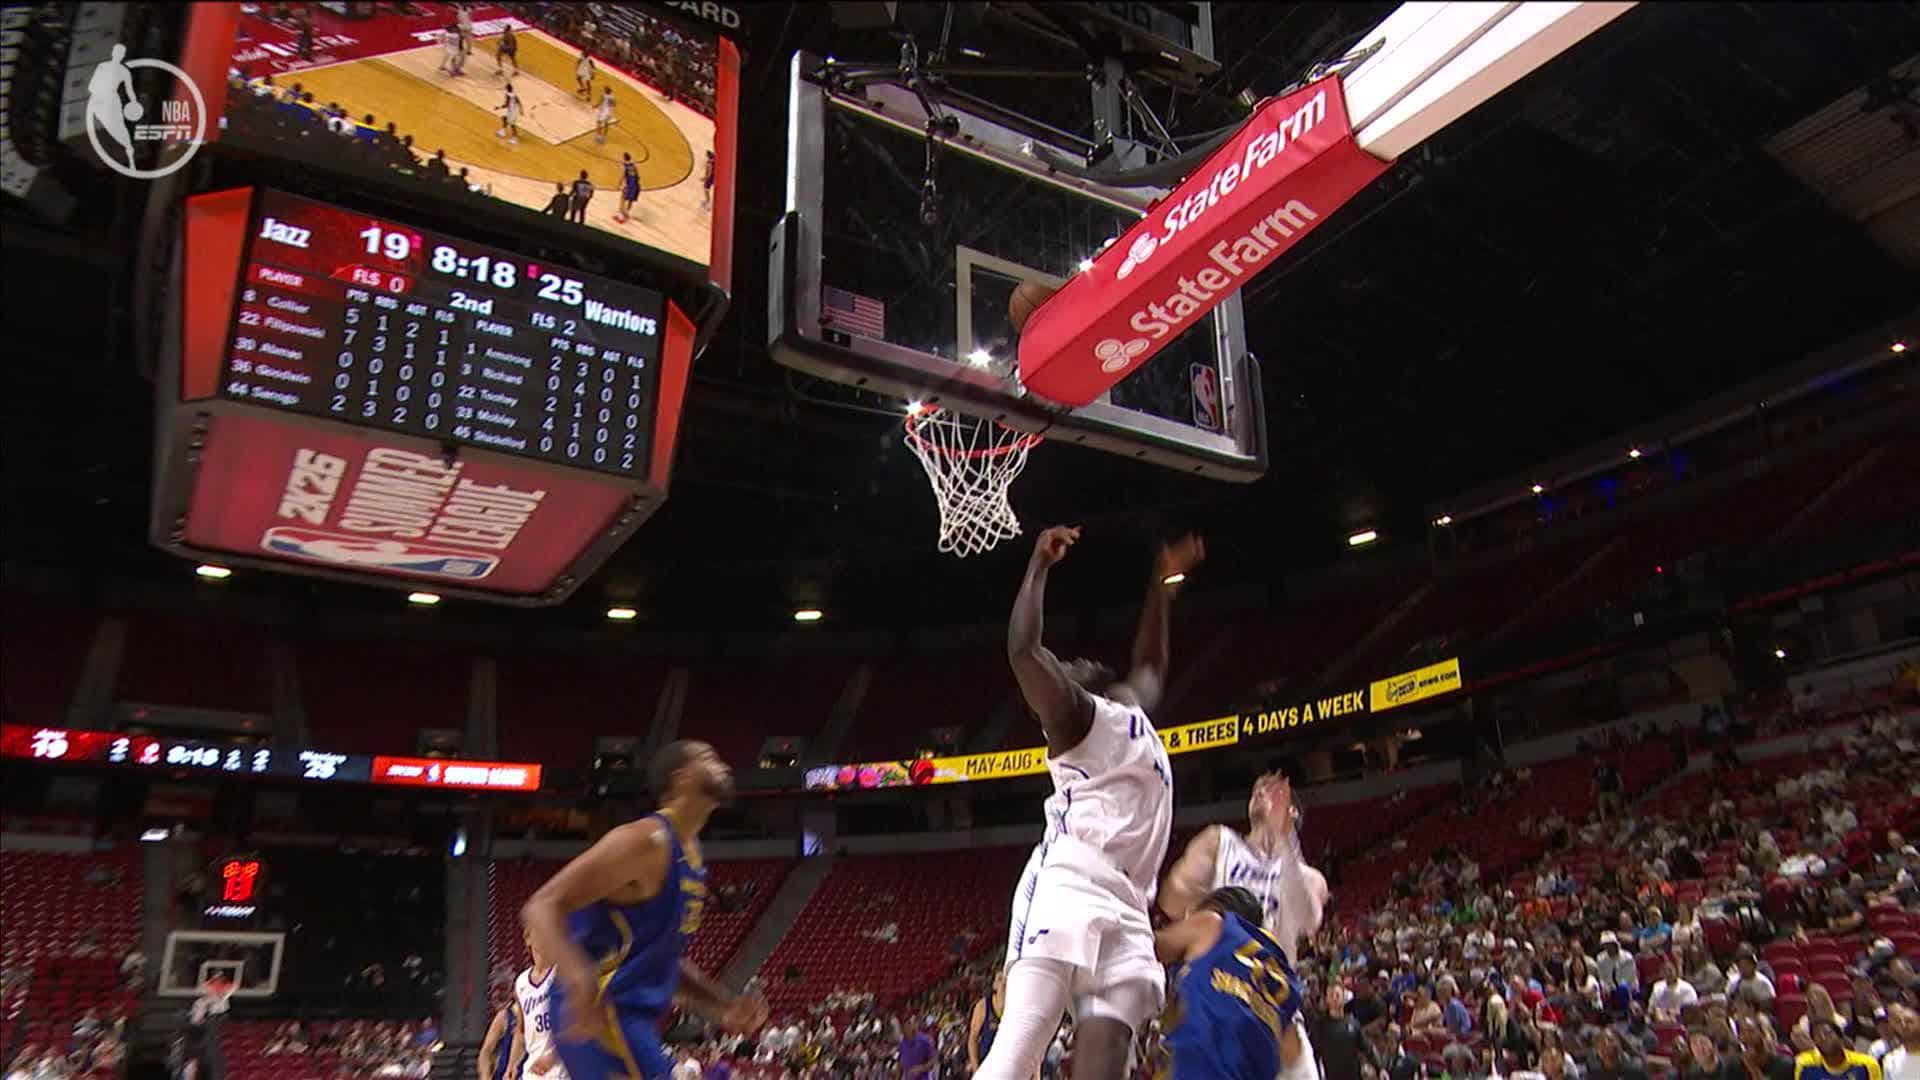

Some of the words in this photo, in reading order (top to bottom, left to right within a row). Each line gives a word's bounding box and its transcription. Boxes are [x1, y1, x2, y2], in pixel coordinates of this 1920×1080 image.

[664, 1, 741, 29] ARD
[259, 217, 311, 248] Jazz
[359, 227, 410, 260] 19
[352, 268, 381, 287] FLS
[389, 277, 405, 293] 0
[431, 245, 516, 288] 8:18
[449, 291, 494, 315] 2nd
[537, 273, 584, 305] 25
[584, 299, 657, 336] Warriors
[238, 311, 261, 326] 22
[344, 329, 357, 345] 7
[372, 336, 386, 352] 3
[404, 343, 415, 359] 1
[436, 350, 446, 366] 1
[345, 308, 360, 324] 5
[377, 315, 388, 331] 1
[405, 322, 420, 338] 2
[439, 329, 449, 345] 1
[531, 312, 556, 329] FLS
[563, 320, 577, 336] 2
[338, 351, 353, 368] 0
[368, 358, 384, 374] 0
[399, 364, 414, 381] 0
[431, 371, 445, 388] 0
[550, 356, 562, 371] 2
[577, 362, 589, 377] 3
[603, 368, 615, 383] 0
[632, 375, 640, 390] 1
[335, 372, 350, 389] 0
[367, 379, 379, 396] 1
[396, 385, 411, 402] 0
[427, 392, 442, 409] 0
[547, 375, 560, 391] 0
[574, 381, 585, 396] 4
[600, 387, 613, 402] 0
[628, 394, 640, 409] 0
[331, 394, 346, 411] 2
[362, 400, 377, 417] 3
[392, 406, 407, 423] 2
[424, 413, 439, 430] 0
[545, 396, 558, 412] 2
[574, 402, 583, 418] 1
[598, 408, 610, 423] 0
[626, 414, 638, 429] 0
[542, 416, 554, 431] 4
[571, 422, 580, 438] 1
[596, 428, 608, 443] 0
[624, 434, 636, 449] 2
[540, 436, 553, 452] 0
[567, 442, 580, 458] 0
[594, 447, 606, 463] 0
[621, 453, 634, 469] 2
[338, 448, 465, 538] SUMMER
[425, 477, 547, 550] LEAGUE
[1170, 733, 1181, 747] &
[1186, 721, 1235, 746] TREES
[1243, 718, 1253, 735] 4
[1258, 707, 1298, 733] DAYS
[1302, 703, 1313, 724] A
[1317, 690, 1365, 719] WEEK
[965, 753, 1032, 777] MAY-AUG
[534, 1012, 551, 1033] 36
